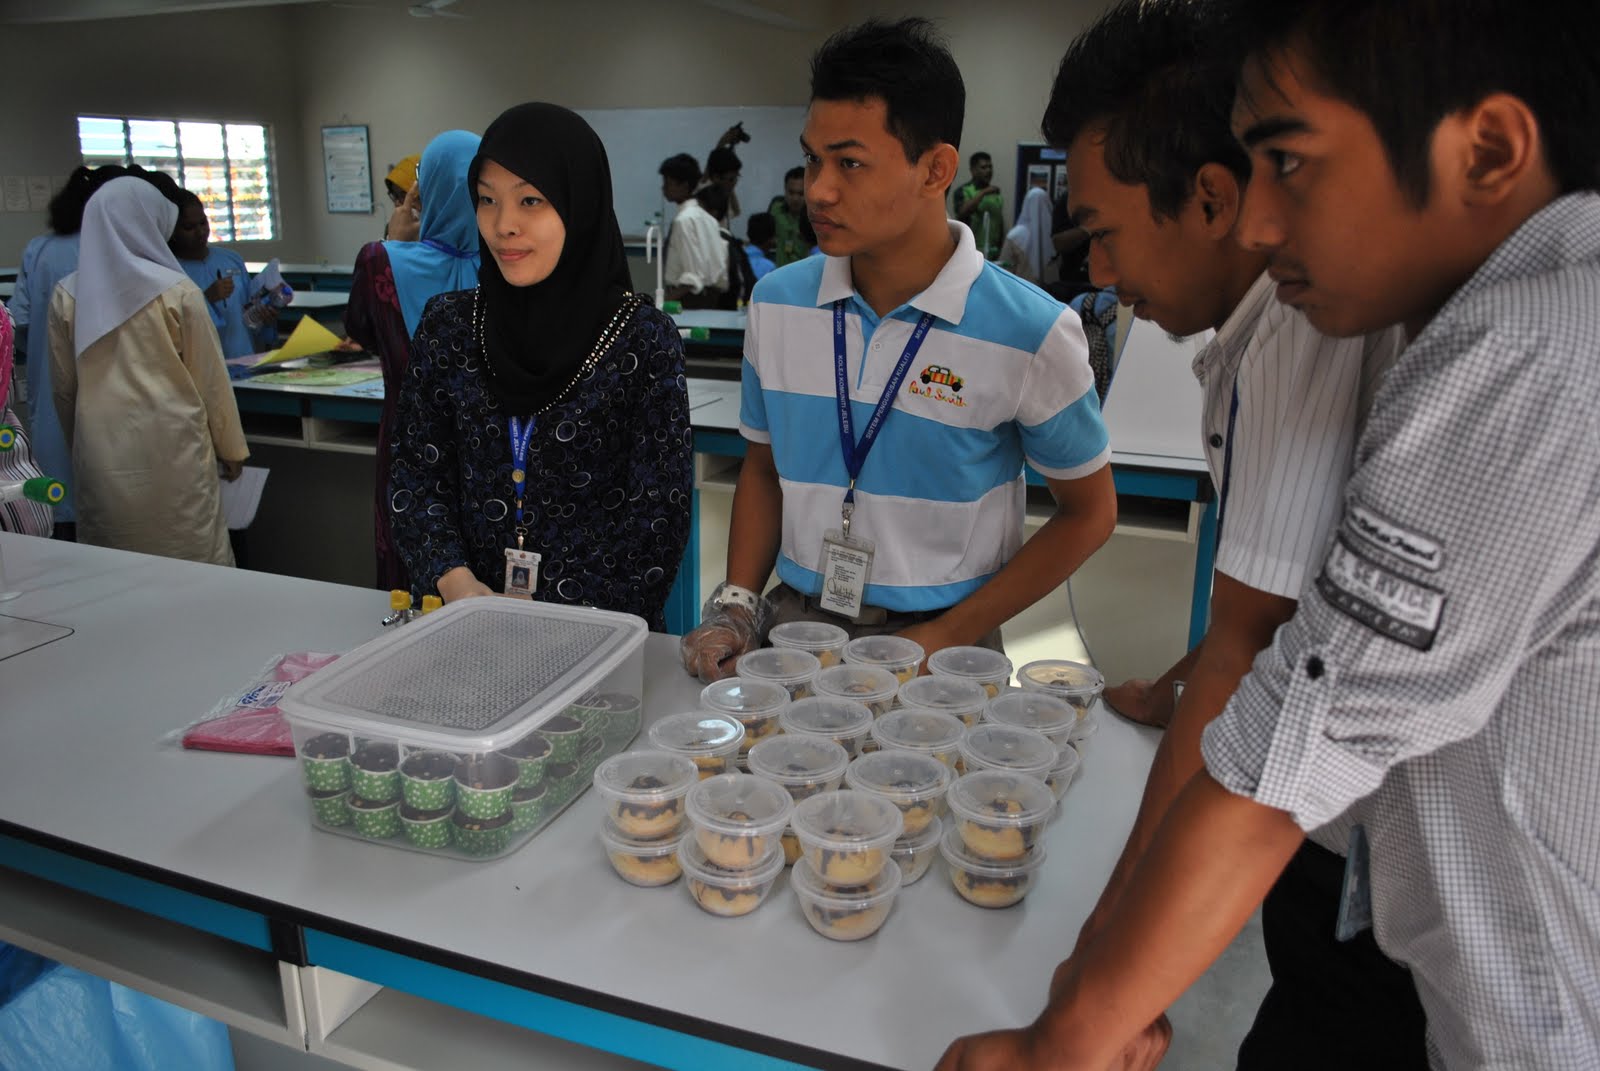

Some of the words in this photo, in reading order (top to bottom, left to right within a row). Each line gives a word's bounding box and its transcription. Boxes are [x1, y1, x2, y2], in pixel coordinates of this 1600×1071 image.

[837, 354, 845, 375] KOLEJ
[838, 377, 848, 407] KOMUNITI
[866, 417, 880, 439] SISTEM
[876, 375, 900, 418] PENGURUSAN
[896, 352, 911, 377] KUALITI
[840, 408, 849, 434] JELEBU
